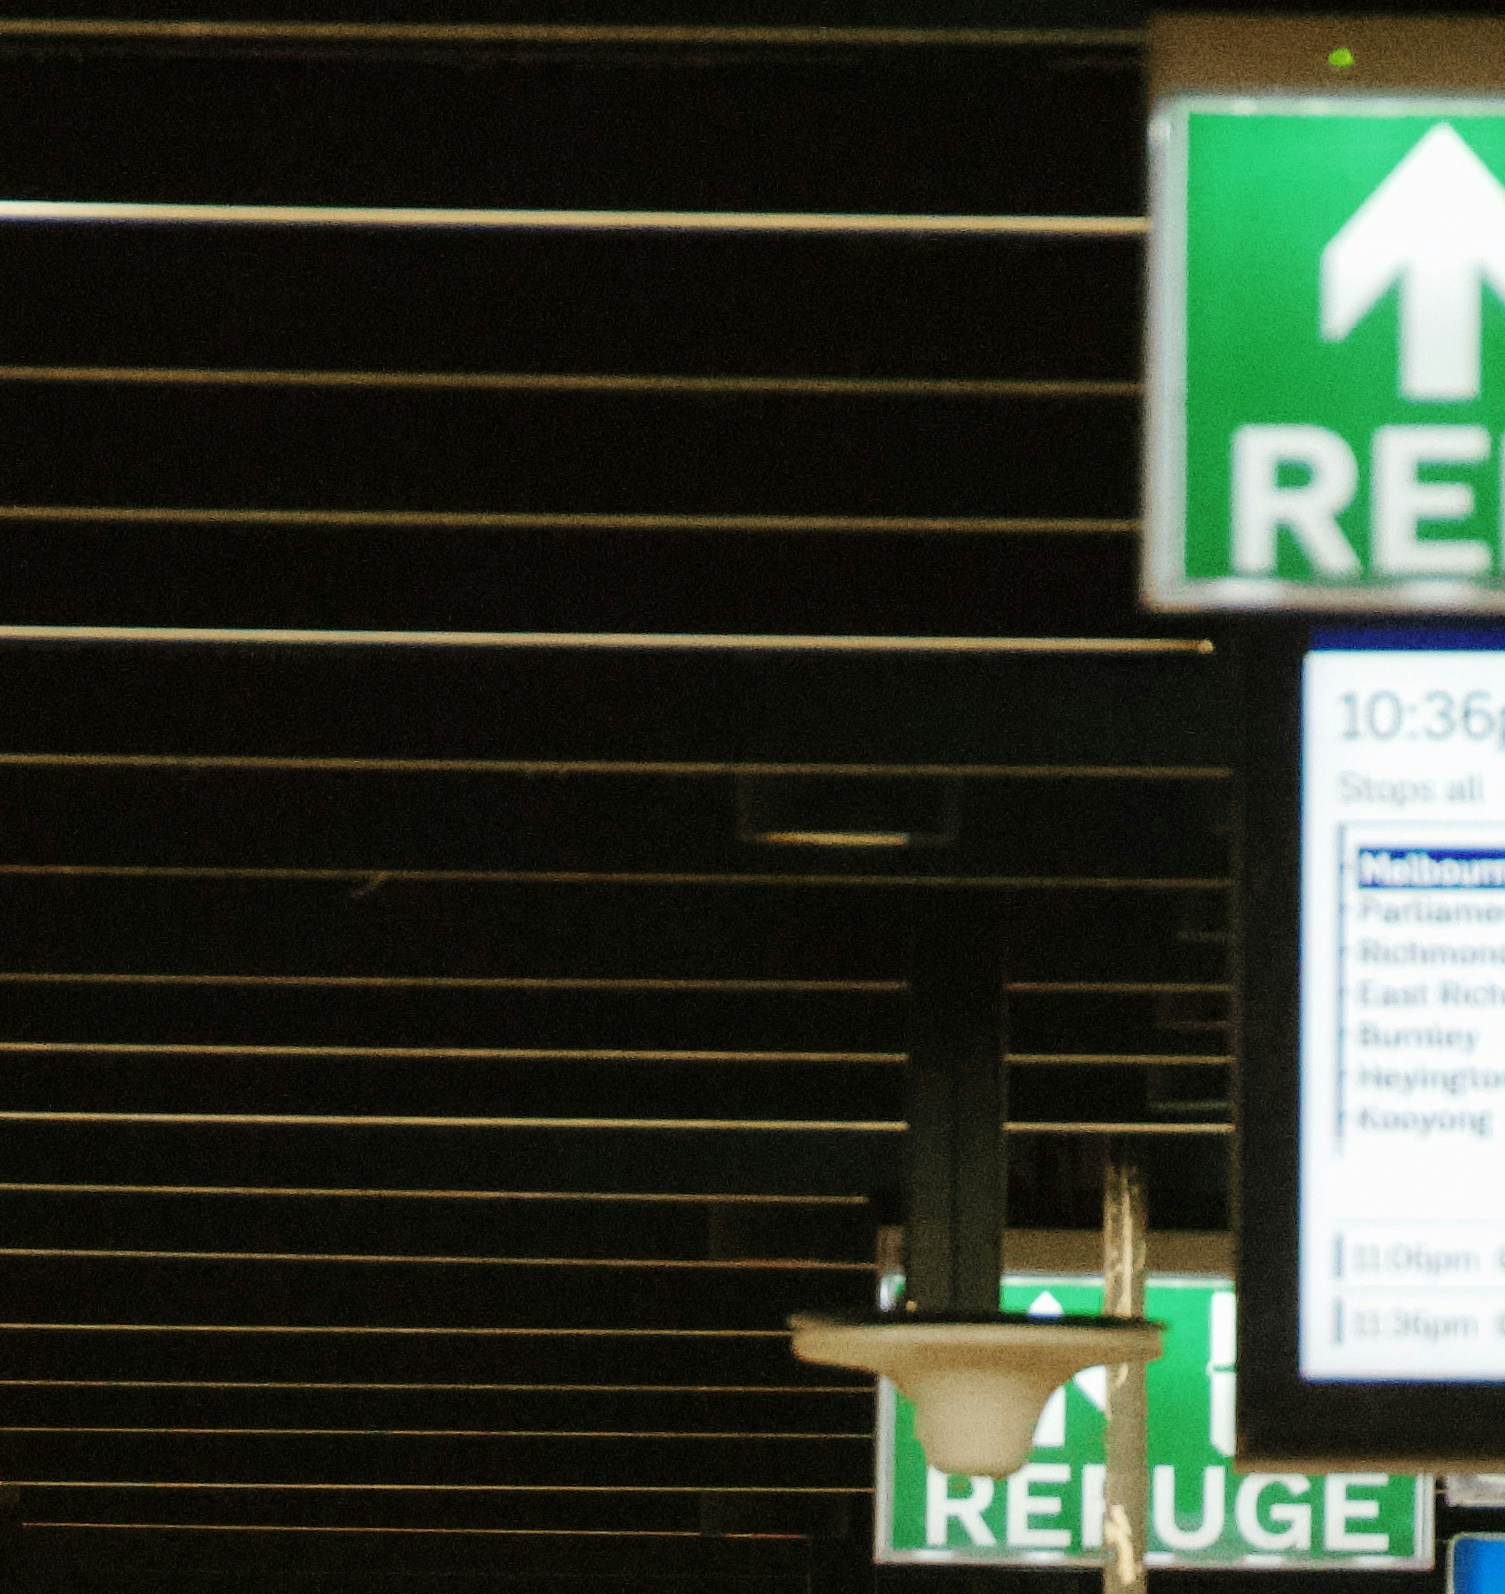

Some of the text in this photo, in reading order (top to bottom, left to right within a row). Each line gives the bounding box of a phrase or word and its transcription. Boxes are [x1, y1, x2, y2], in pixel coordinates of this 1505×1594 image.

[1338, 772, 1482, 810] Stops all
[1357, 981, 1430, 1009] East
[1357, 1021, 1478, 1055] Burnley
[1357, 1107, 1493, 1140] Kooyong
